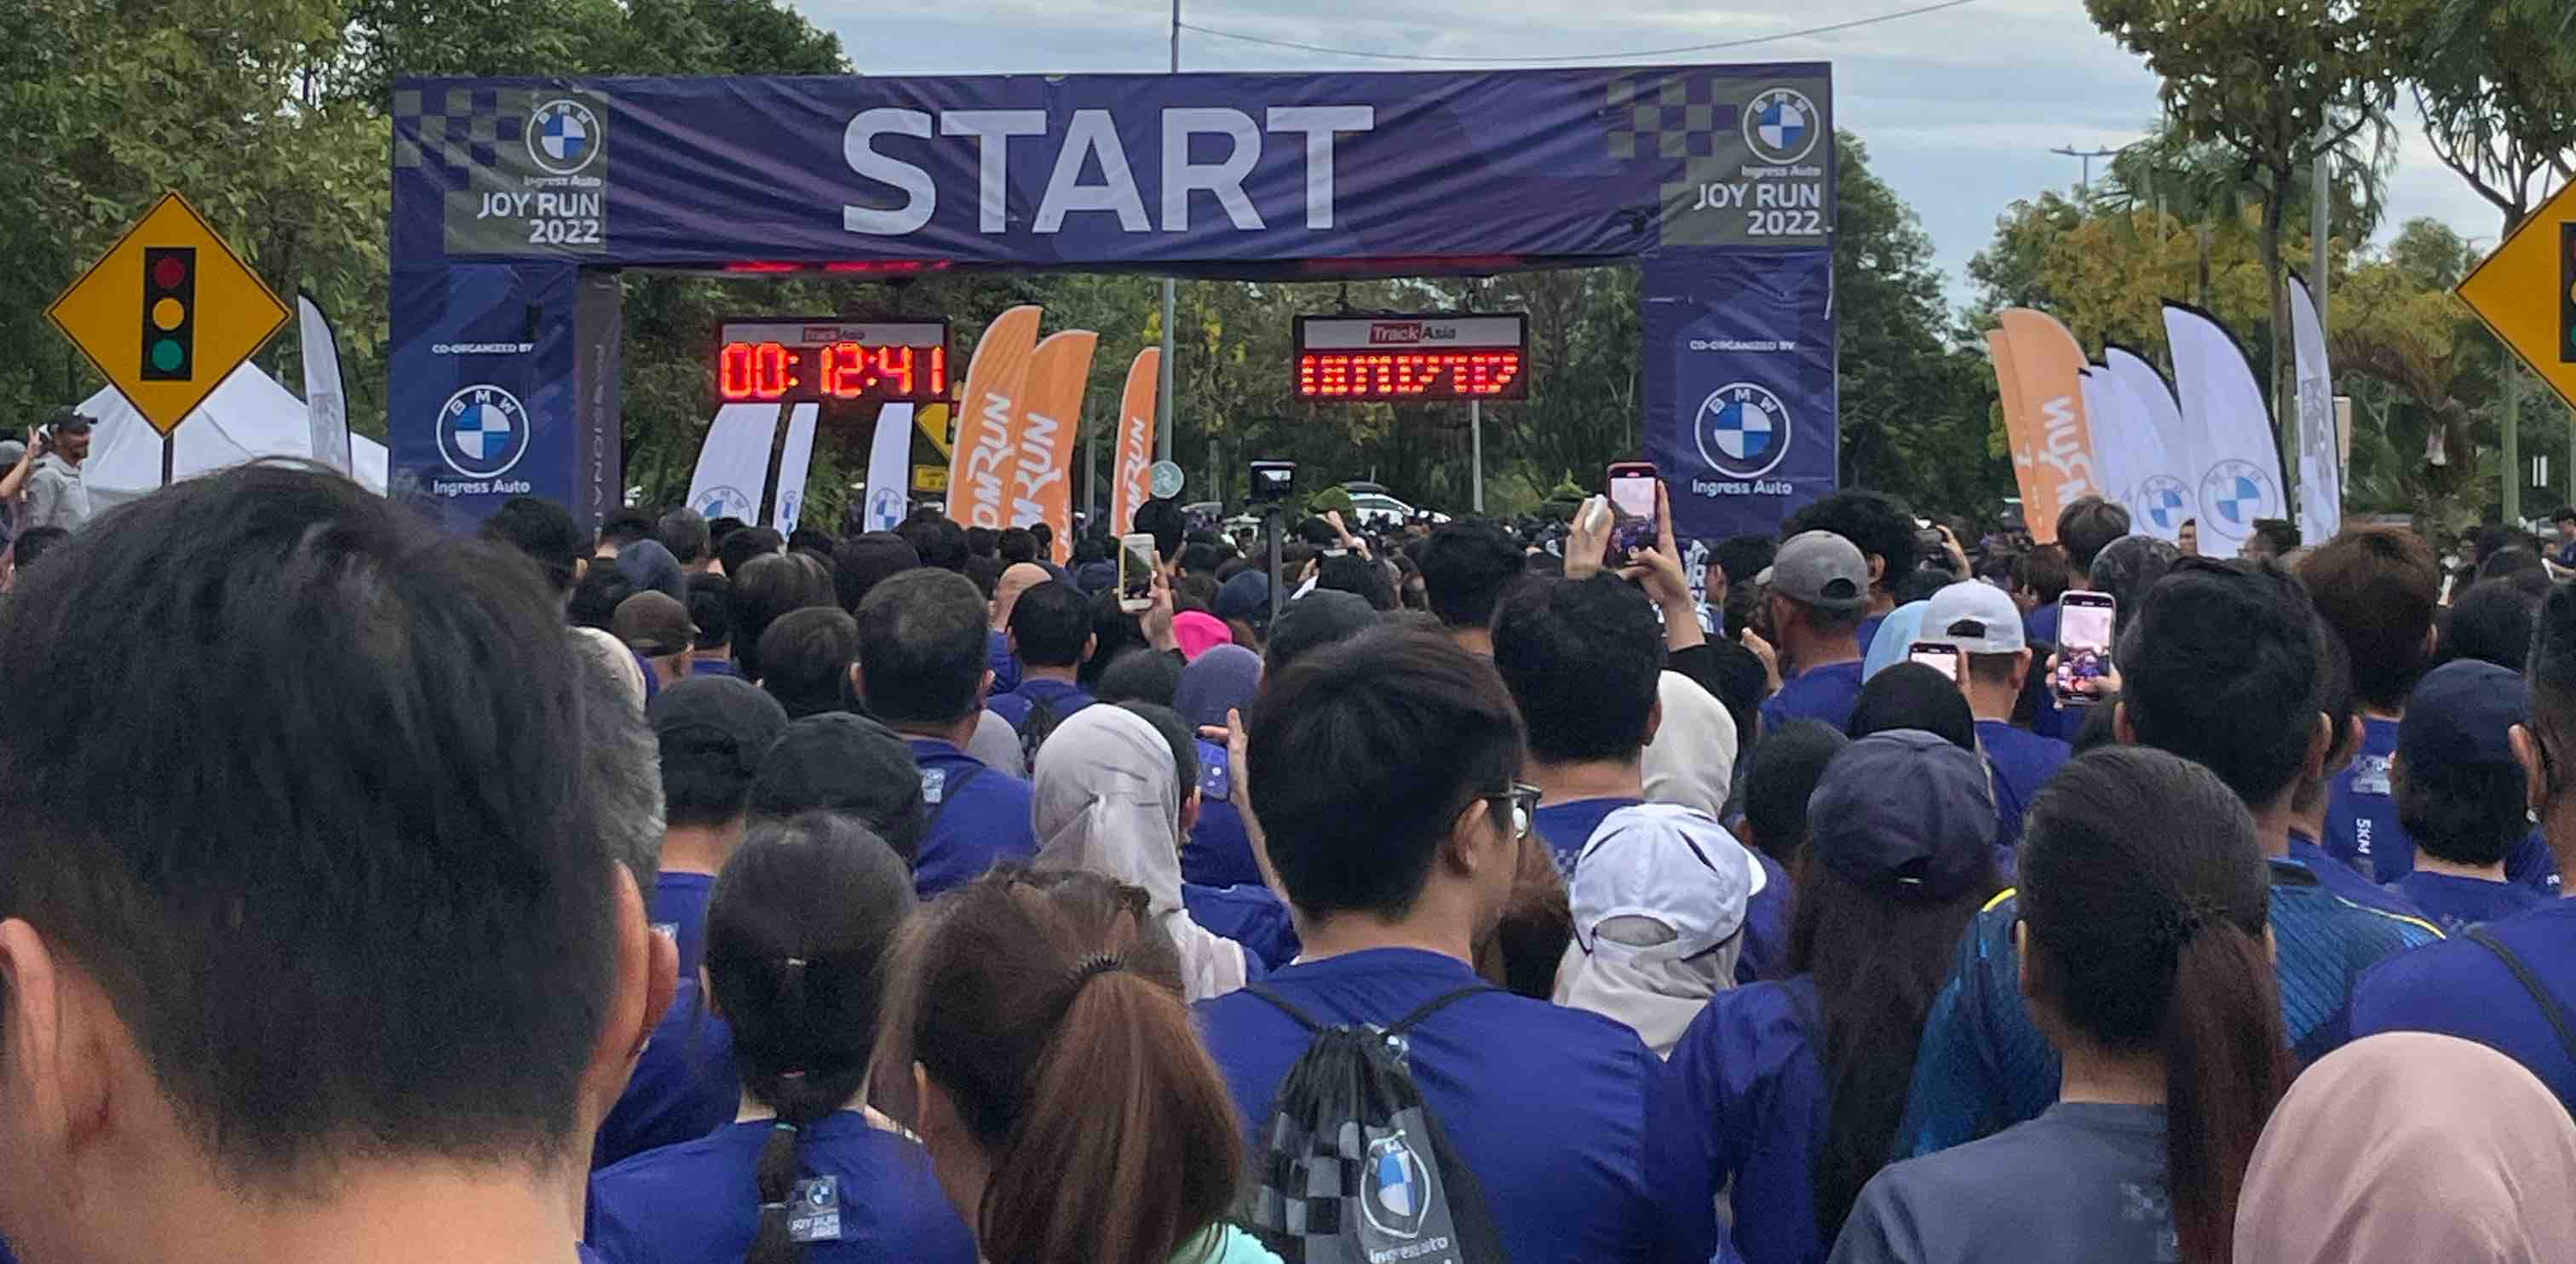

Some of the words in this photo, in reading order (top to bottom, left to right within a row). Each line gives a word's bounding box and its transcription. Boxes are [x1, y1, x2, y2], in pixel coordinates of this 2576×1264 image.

[843, 106, 1374, 236] START
[477, 192, 530, 219] JOY
[538, 193, 600, 217] RUN
[1693, 182, 1748, 210] JOY
[1757, 183, 1820, 208] RUN
[529, 219, 601, 244] 2022
[1747, 210, 1821, 235] 2022
[432, 343, 516, 353] CO-ORGANIZED
[519, 342, 533, 353] BY
[721, 342, 945, 398] 00:12:41
[450, 390, 516, 416] BMW
[1709, 388, 1777, 415] BMW
[433, 481, 489, 497] Ingress
[492, 480, 531, 493] Auto
[1692, 480, 1751, 497] Ingress
[1753, 480, 1792, 494] Auto
[2356, 817, 2372, 854] 5KM
